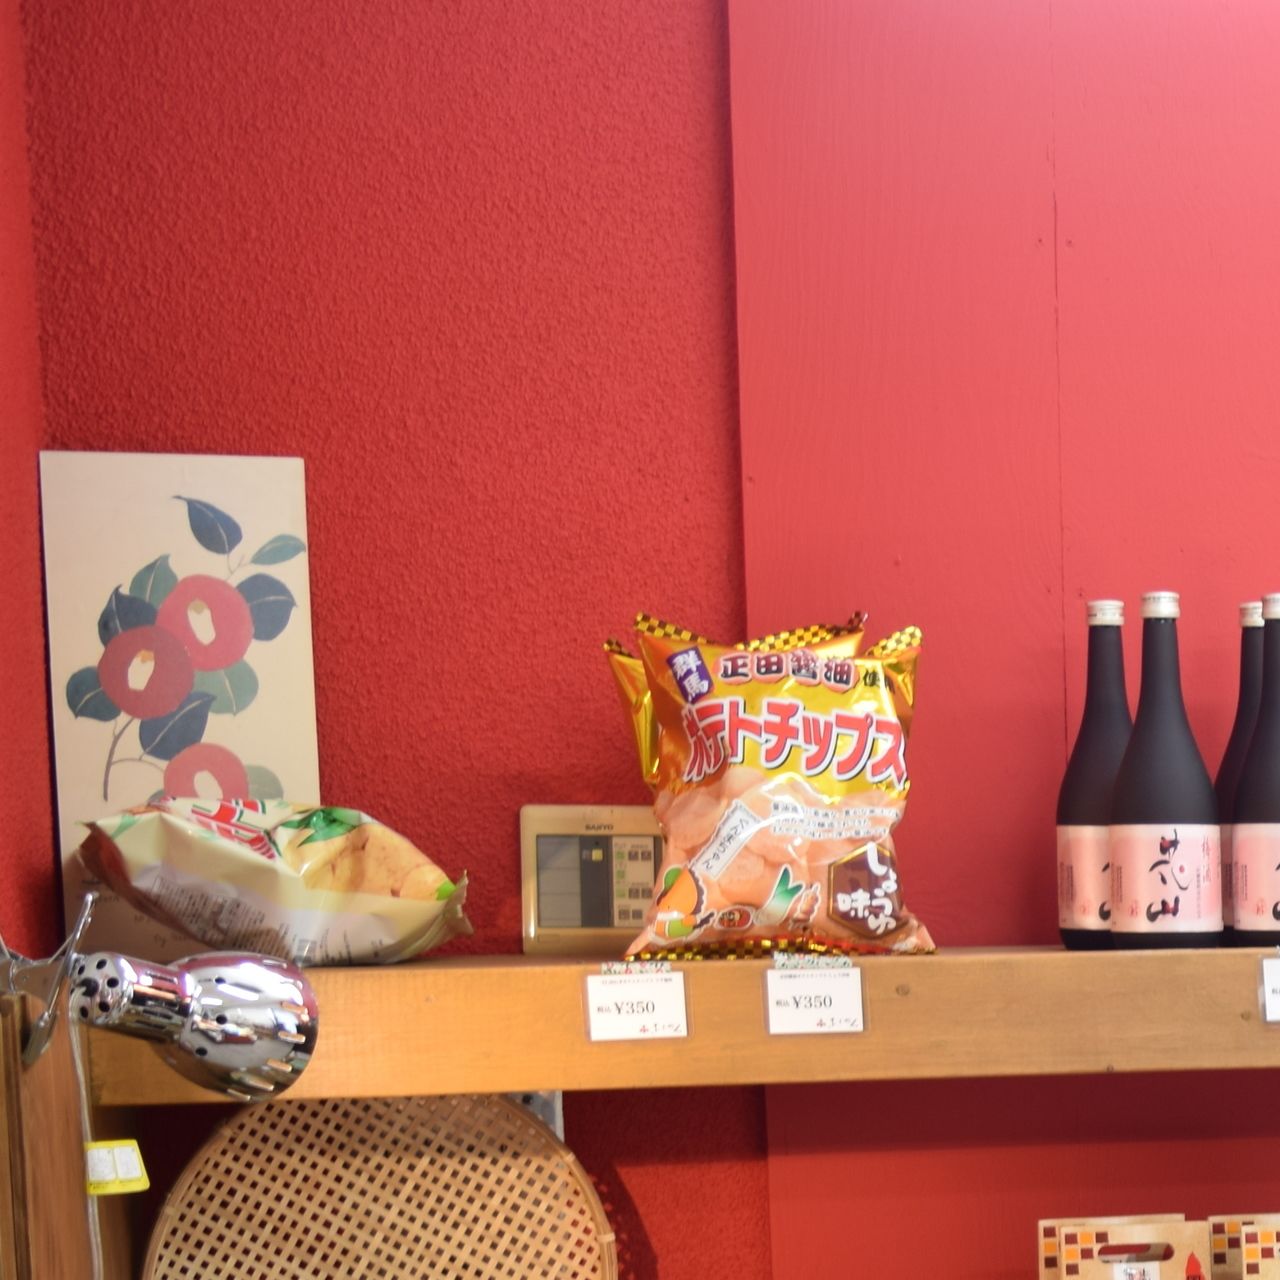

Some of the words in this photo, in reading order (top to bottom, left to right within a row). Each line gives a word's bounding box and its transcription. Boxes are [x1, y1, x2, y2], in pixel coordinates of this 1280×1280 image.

[683, 699, 906, 789] ポテトチップス
[837, 889, 870, 917] 味
[614, 1000, 655, 1016] ¥350
[792, 994, 833, 1010] ¥350
